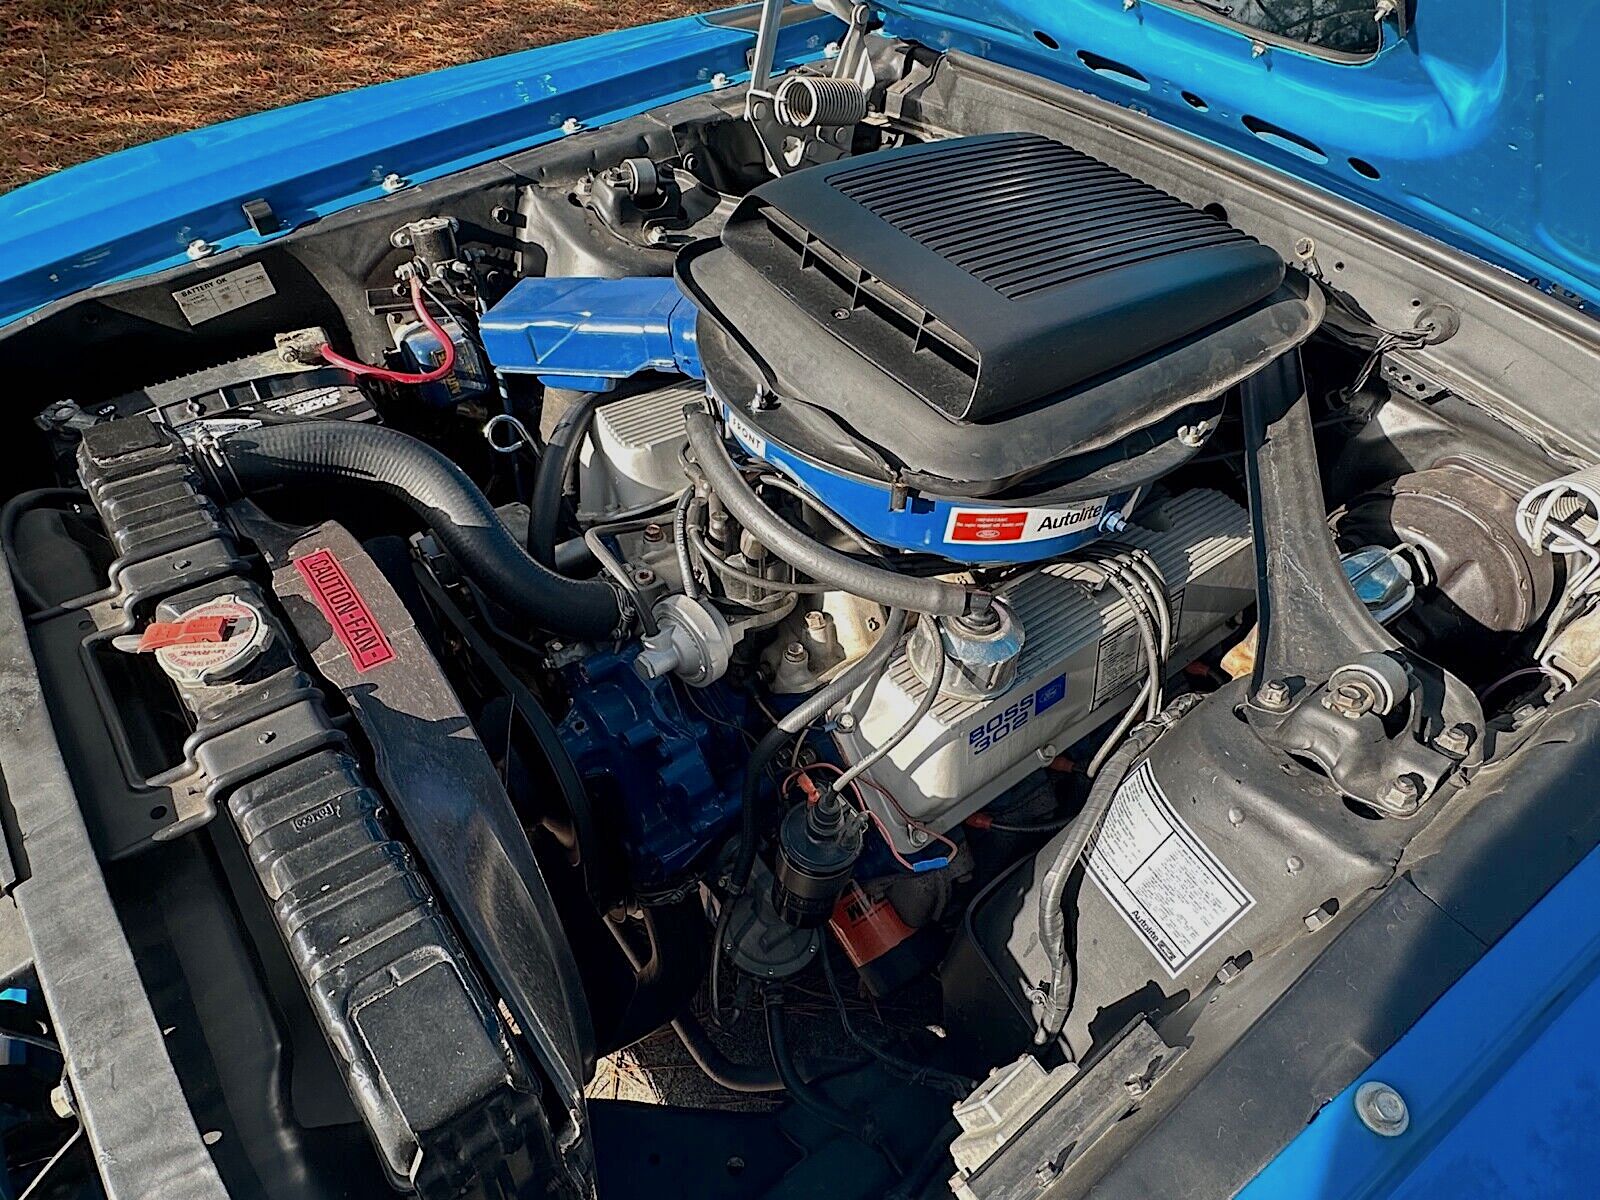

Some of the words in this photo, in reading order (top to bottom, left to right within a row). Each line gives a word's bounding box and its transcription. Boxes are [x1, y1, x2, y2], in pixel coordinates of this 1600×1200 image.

[181, 281, 214, 298] BATTERY
[216, 276, 228, 286] OK
[1037, 505, 1102, 532] Autolite
[968, 693, 1034, 746] BOSS
[974, 711, 1029, 755] 302
[1131, 909, 1159, 943] Autolite
